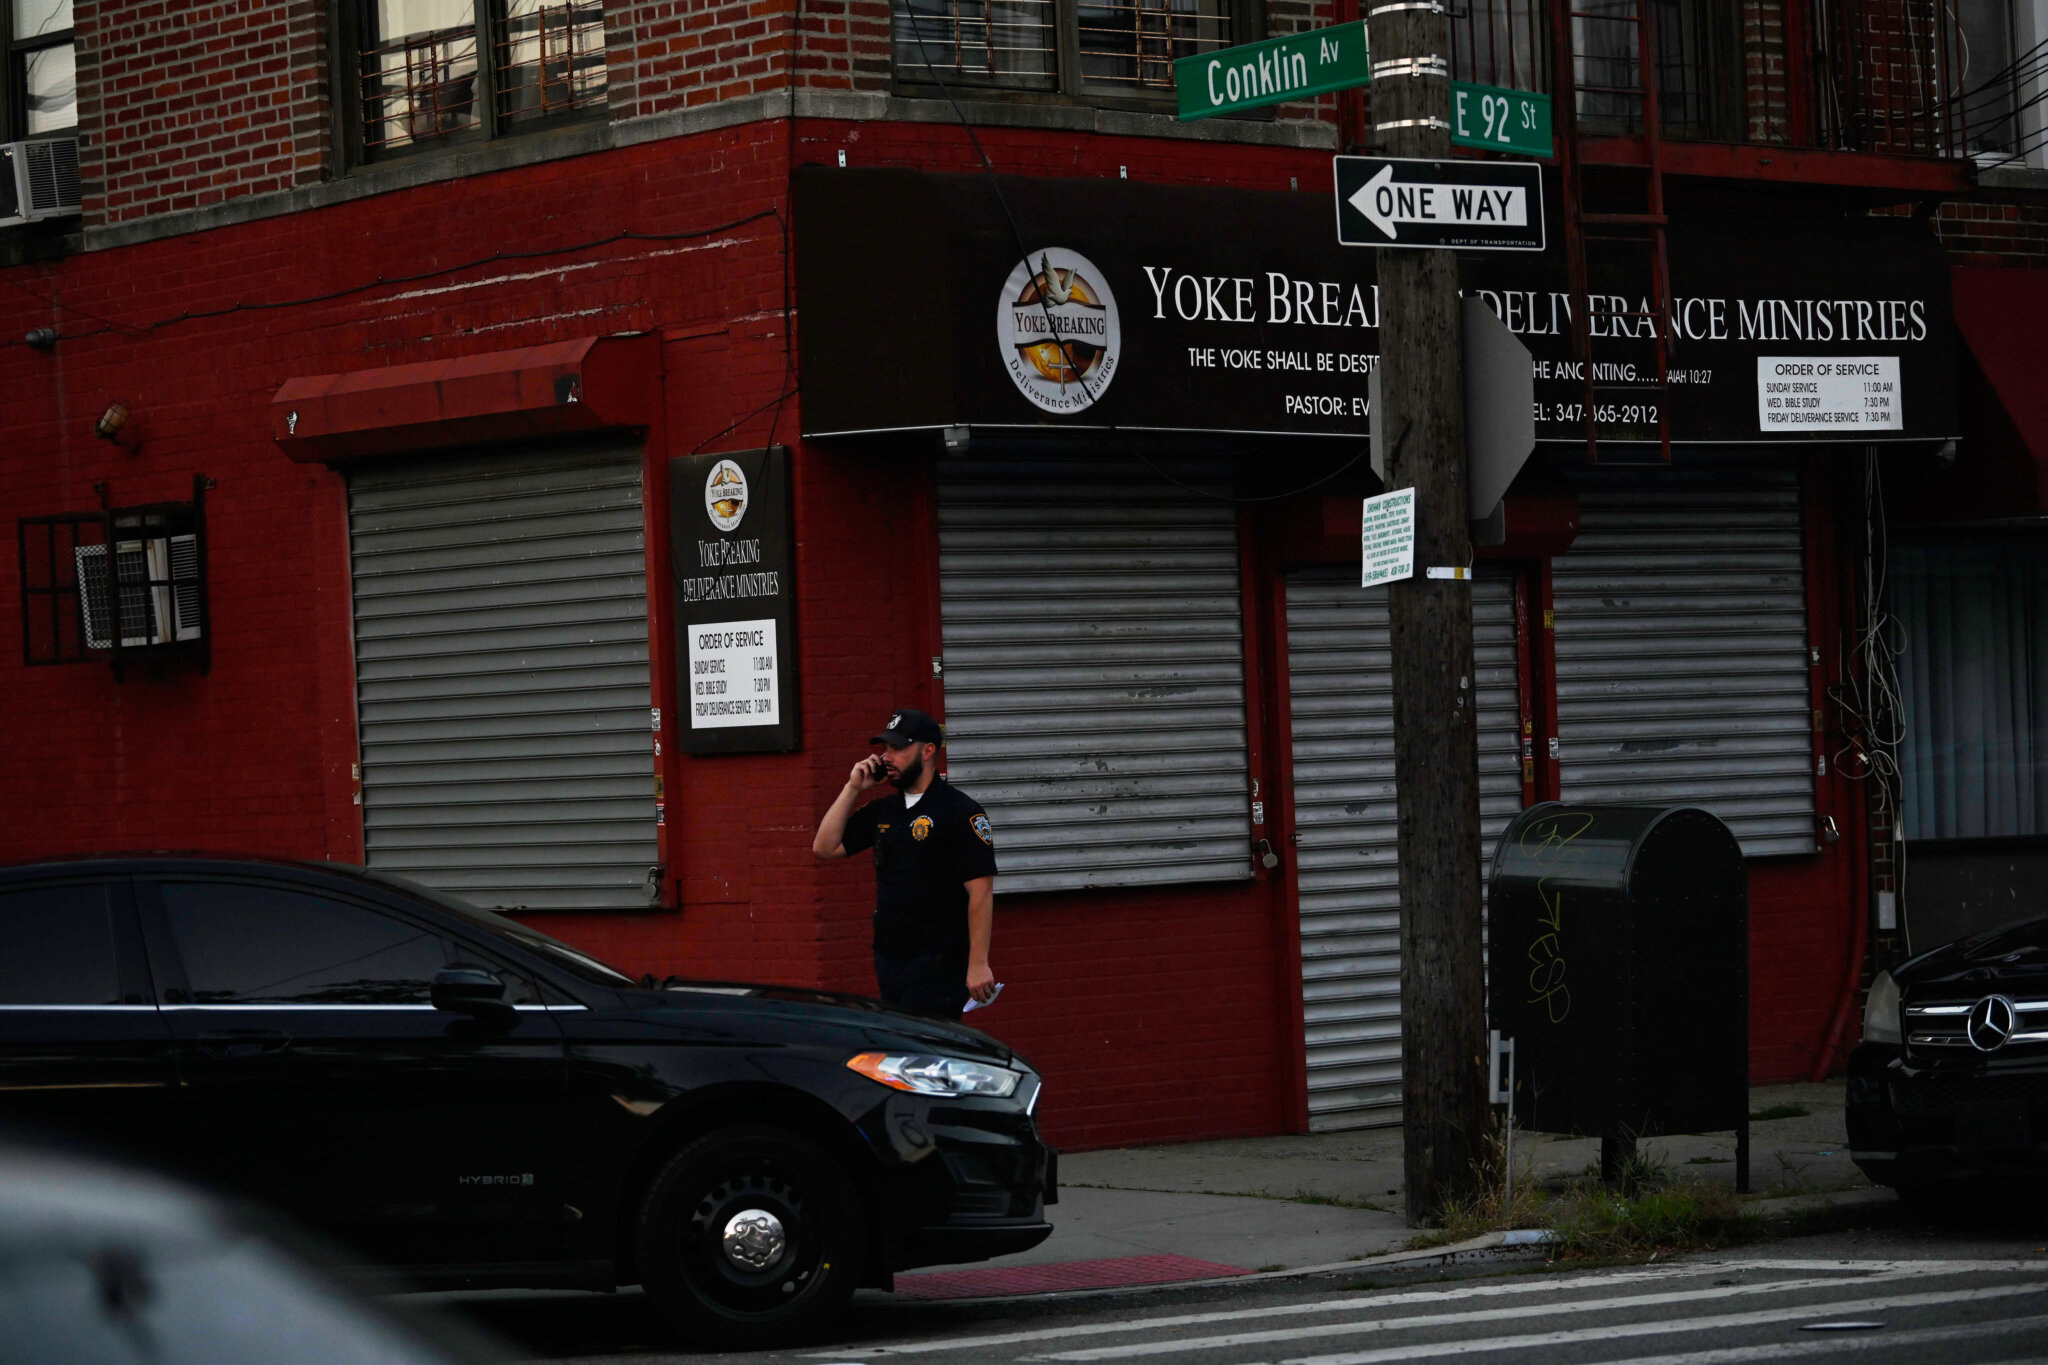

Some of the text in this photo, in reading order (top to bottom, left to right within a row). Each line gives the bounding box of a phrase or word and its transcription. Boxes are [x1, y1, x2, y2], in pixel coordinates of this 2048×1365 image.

[1208, 37, 1340, 106] Conklin Av
[1457, 91, 1537, 143] E 92 St
[1376, 187, 1513, 221] ONE WAY
[1480, 239, 1537, 247] TRANSPORTATION
[1143, 266, 1257, 323] YOKE
[1736, 299, 1927, 341] MINISTRIES
[1015, 312, 1105, 335] YOKE BREAKING
[1188, 348, 1216, 368] THE
[1221, 349, 1262, 369] YOKE
[1266, 351, 1312, 372] SHALL
[1317, 353, 1334, 372] BE
[1532, 360, 1551, 379] HE
[1555, 362, 1659, 382] ANONTING.....
[1690, 369, 1712, 384] 10:27
[1775, 363, 1880, 376] ORDER OF SERVICE
[1009, 356, 1115, 409] Deliverance Miistries
[1766, 382, 1893, 393] SUNDAY SERVICE 11:00 AM
[1286, 395, 1347, 416] PASTOR:
[1533, 403, 1551, 422] EL:
[1766, 397, 1890, 408] WED. BIBLE STUDY 7:30 PM
[1767, 412, 1891, 423] FRIDAY DELIVERANCE SERVICE 7:30 PM
[698, 538, 760, 568] YOKE BREAKING
[684, 571, 779, 602] DELIVERANCE MINISTRIES
[699, 630, 763, 650] ORDER OF SERVICE
[694, 656, 772, 674] SUNDAY SERVICE 11:00 AM
[695, 678, 770, 695] WED. BIBLE STUDY 7:30 PM
[696, 702, 708, 716] FRIDAY
[709, 701, 734, 715] DELIVERANCE
[735, 700, 751, 714] SERVICE
[764, 699, 771, 712] PM
[459, 1175, 521, 1185] HYBRID
